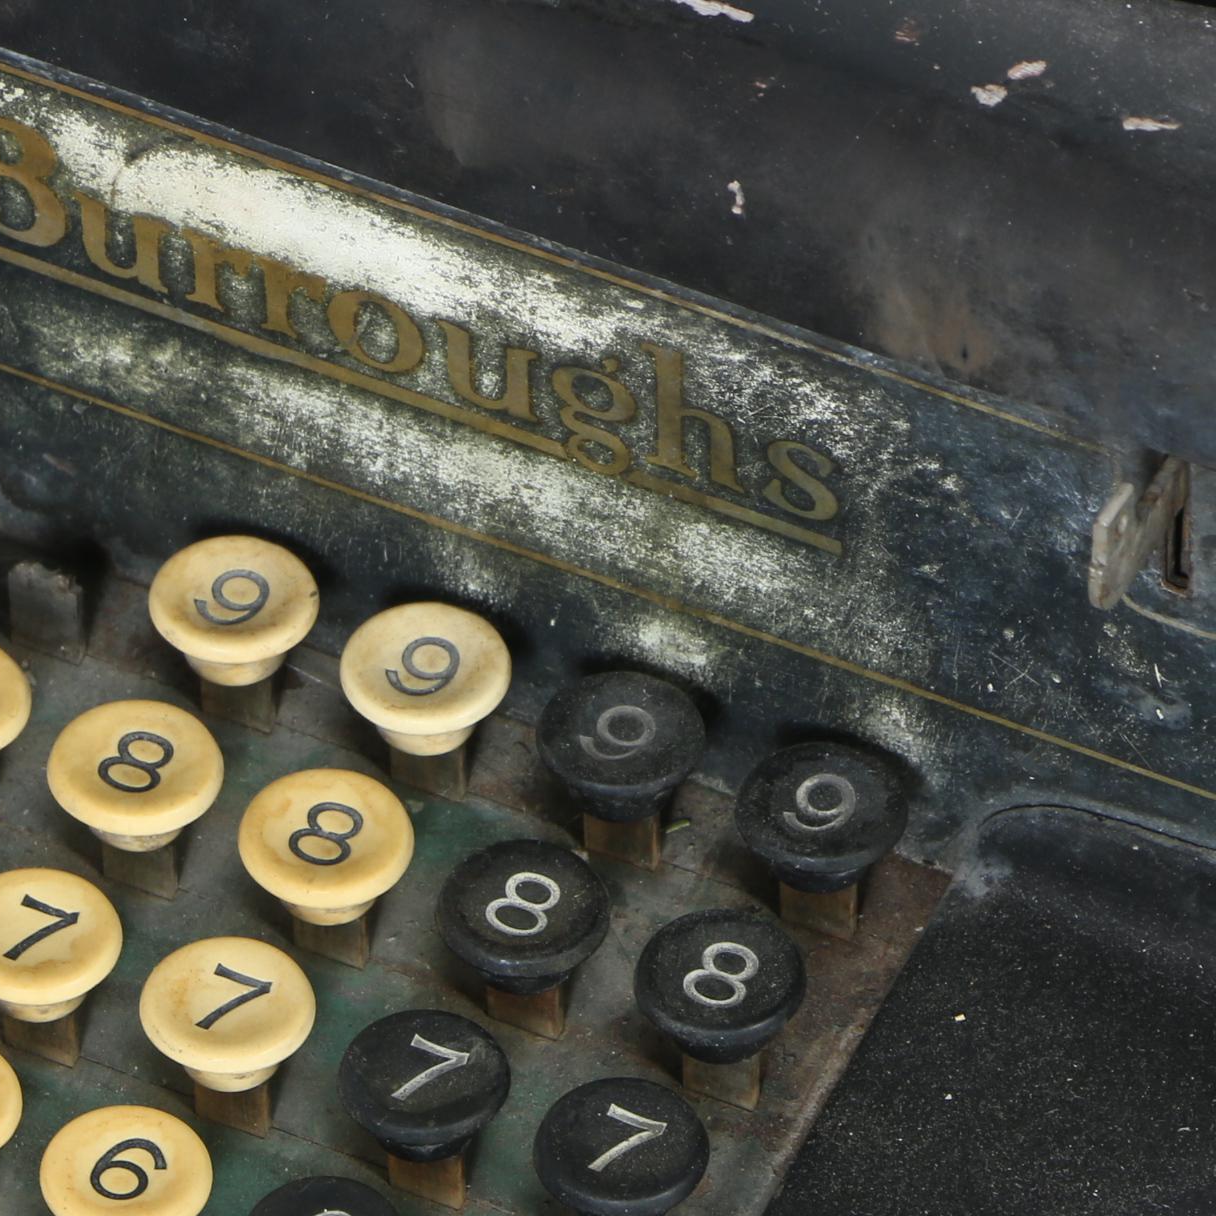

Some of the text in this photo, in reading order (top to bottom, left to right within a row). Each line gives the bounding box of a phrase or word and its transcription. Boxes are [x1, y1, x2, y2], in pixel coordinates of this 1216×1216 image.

[200, 570, 275, 634] 9
[390, 637, 460, 698] 9
[98, 731, 174, 794] 8
[581, 704, 656, 762] 9
[288, 802, 363, 866] 8
[783, 774, 855, 831] 9
[6, 895, 79, 960] 7
[486, 872, 560, 935] 8
[196, 963, 271, 1030] 7
[683, 942, 759, 1006] 8
[394, 1034, 469, 1099] 7
[90, 1138, 167, 1200] 6
[593, 1103, 666, 1171] 7
